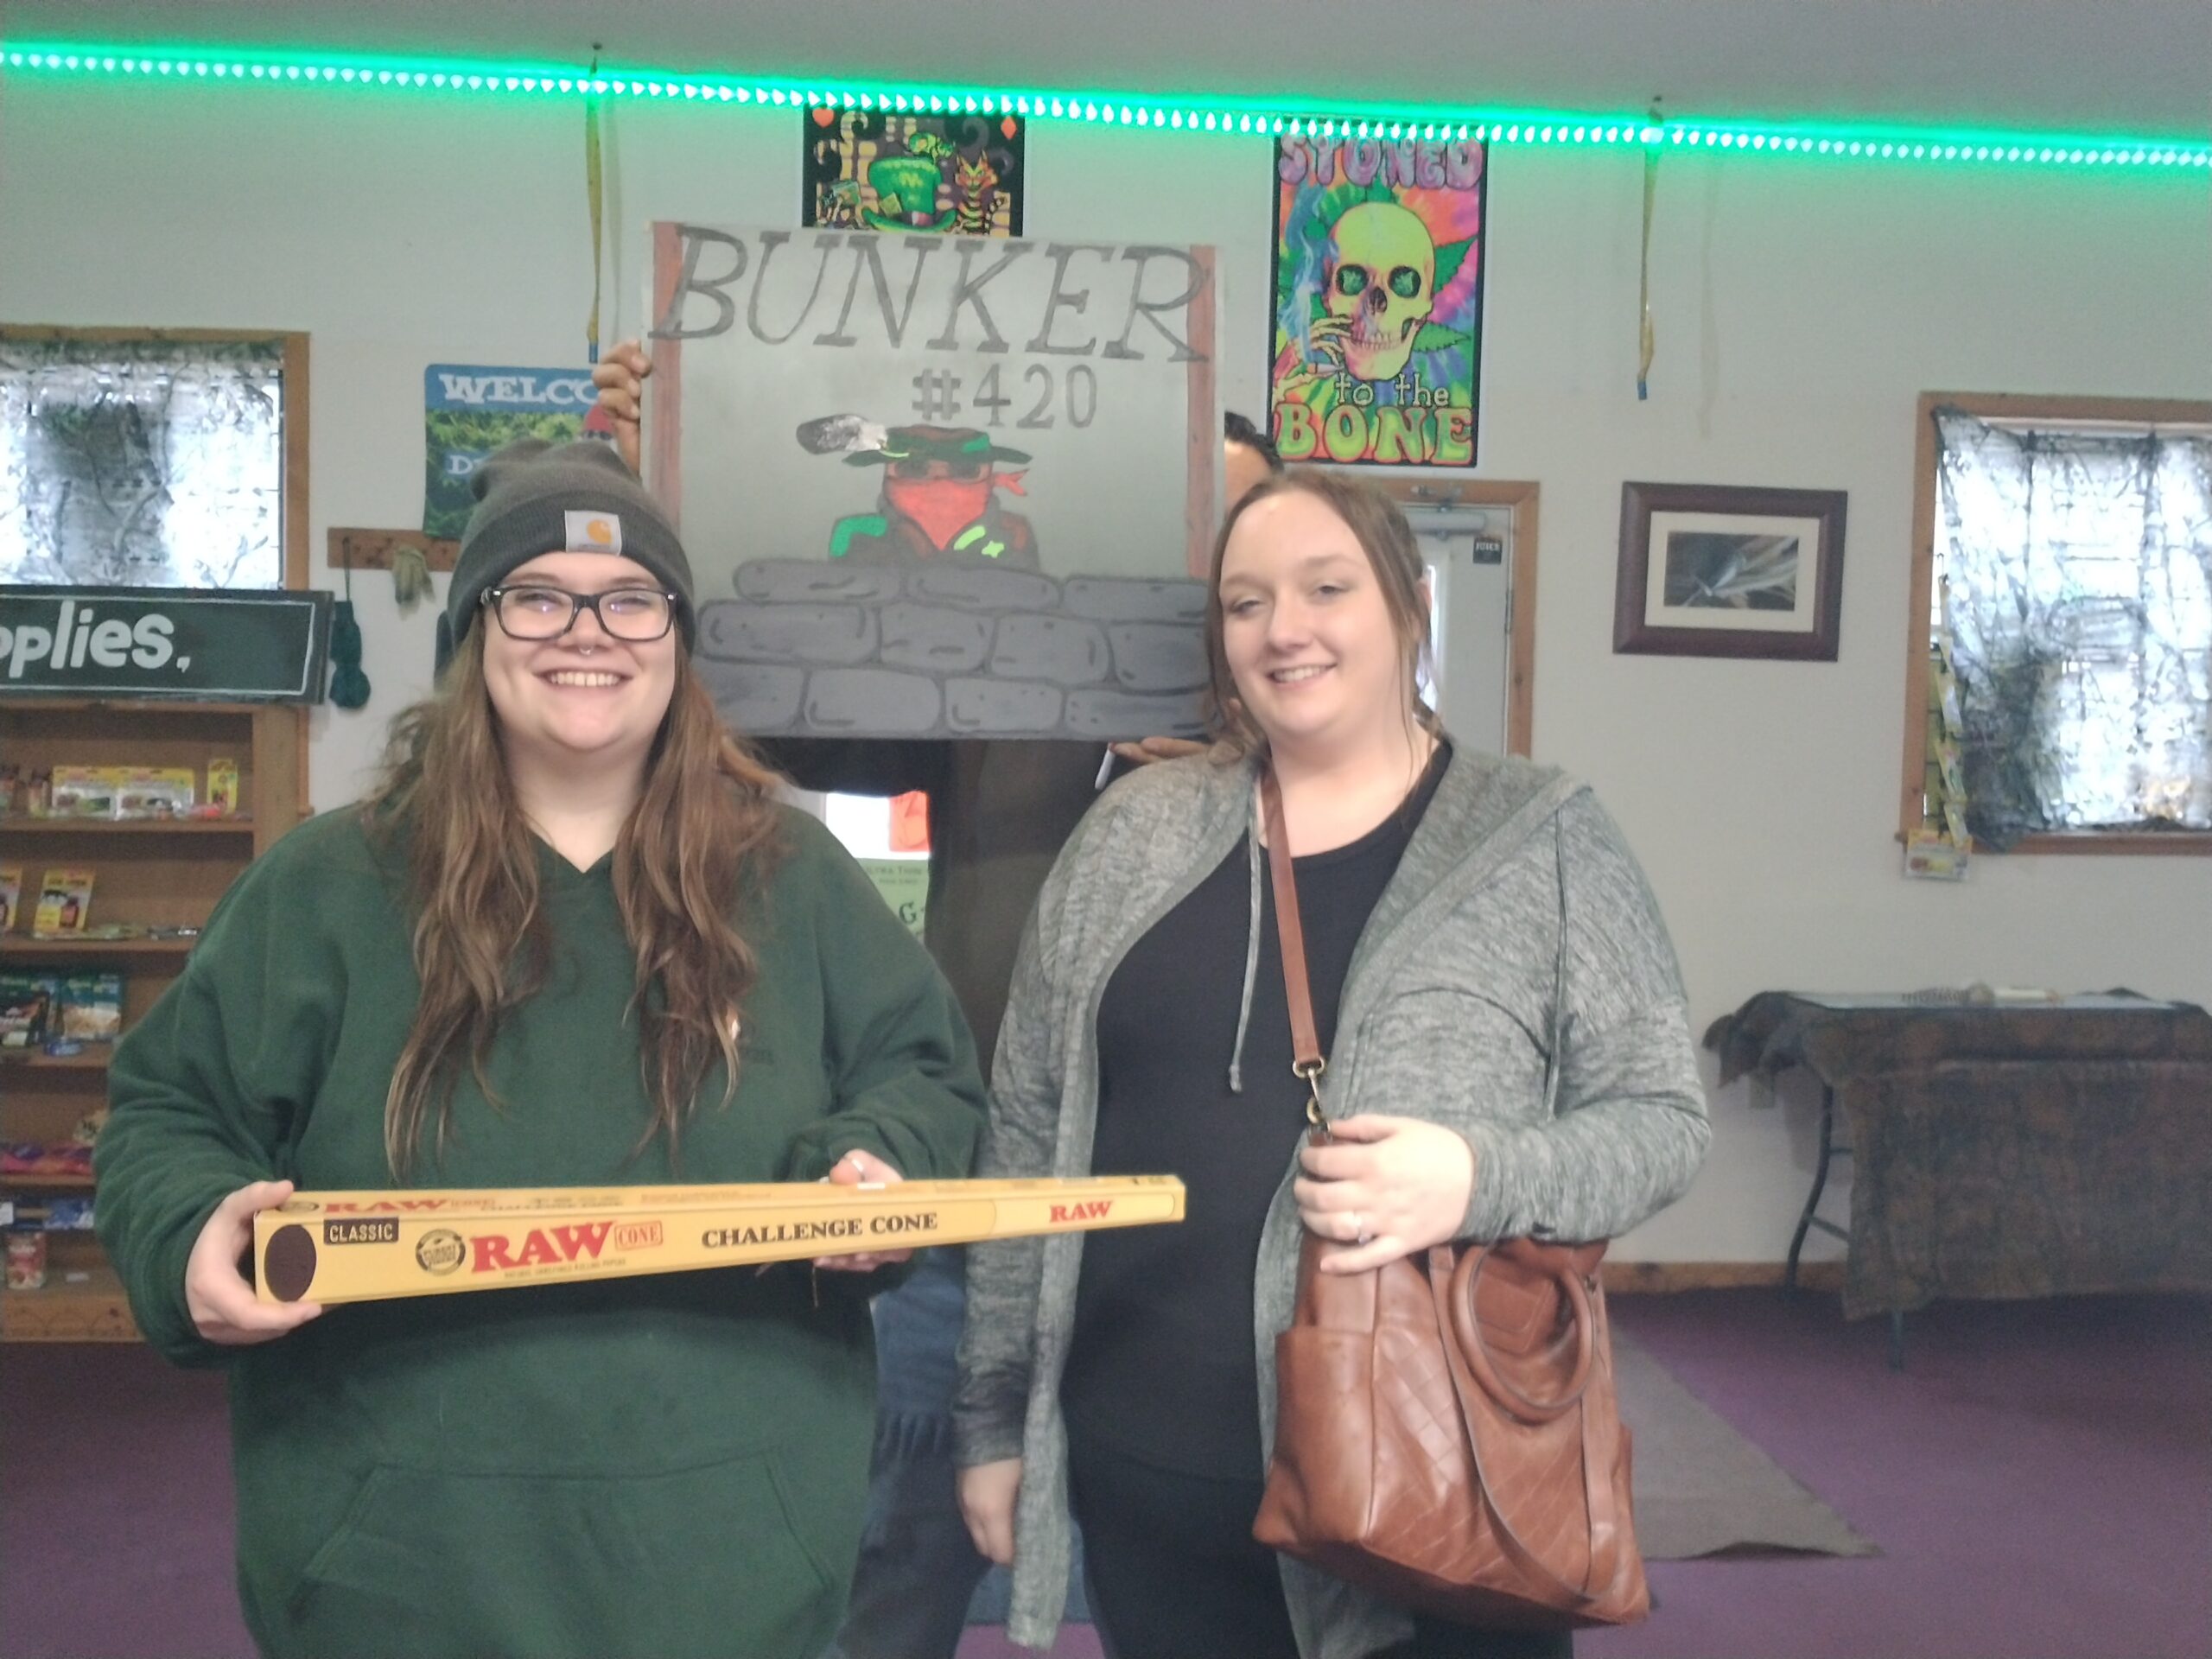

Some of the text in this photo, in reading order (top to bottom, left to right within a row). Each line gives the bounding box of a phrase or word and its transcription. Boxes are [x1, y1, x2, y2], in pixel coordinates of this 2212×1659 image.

[1279, 132, 1484, 190] STONED
[647, 226, 1211, 363] BUNKER
[439, 374, 600, 404] WELCO
[912, 363, 1097, 429] #420
[1334, 372, 1451, 408] to the
[1275, 403, 1474, 465] BONE
[702, 1211, 938, 1248] CHALLENGE CONE
[1049, 1200, 1113, 1223] RAW
[329, 1224, 393, 1243] CLASSIC
[470, 1221, 615, 1273] RAW
[617, 1224, 659, 1246] CONE
